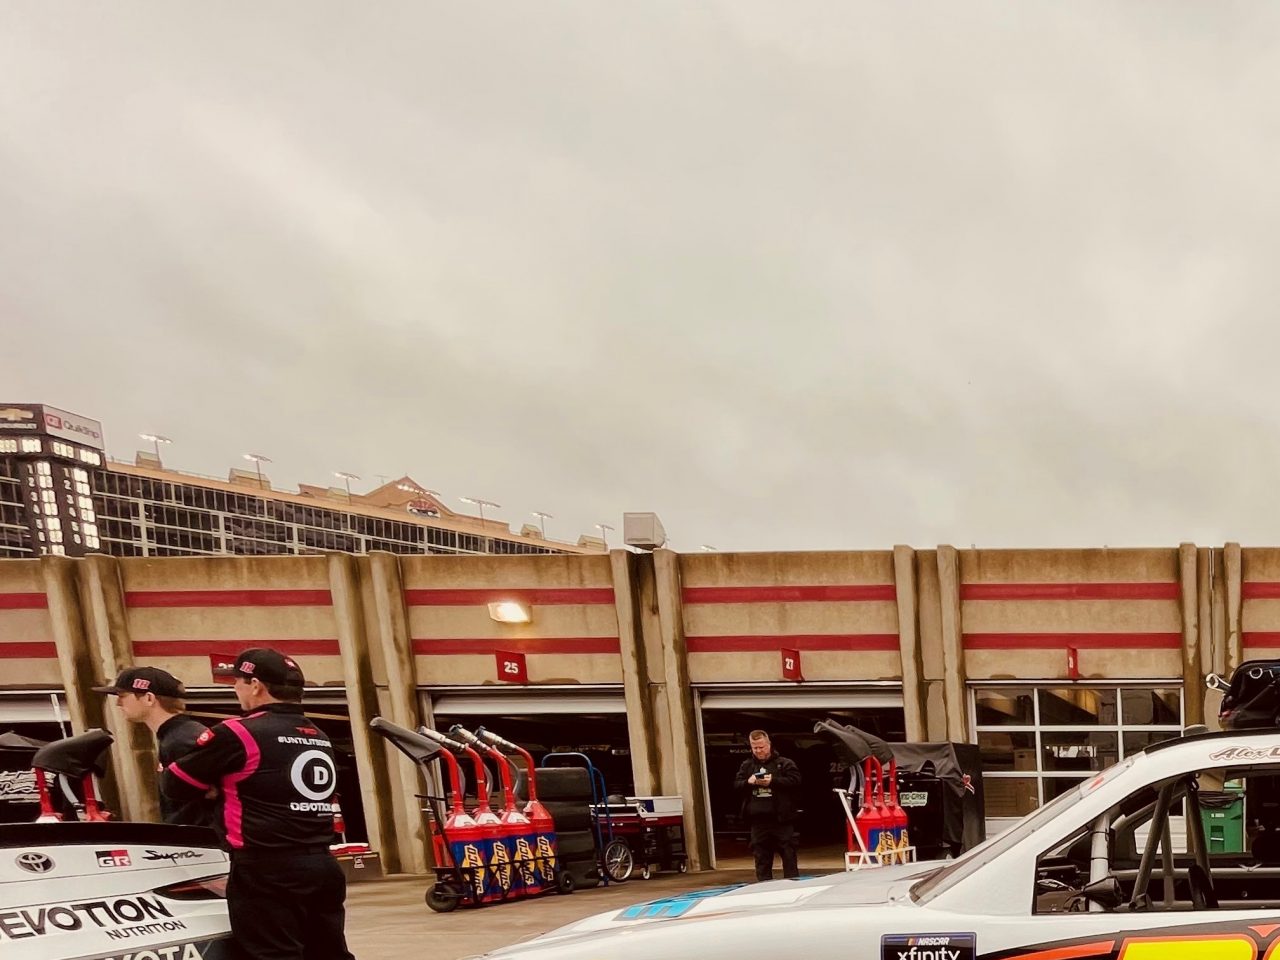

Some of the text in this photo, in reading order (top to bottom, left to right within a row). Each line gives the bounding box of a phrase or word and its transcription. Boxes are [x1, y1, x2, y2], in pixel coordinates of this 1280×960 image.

[504, 661, 519, 674] 25
[1210, 746, 1270, 761] Alex
[98, 856, 131, 867] GR
[142, 849, 203, 864] Supra
[105, 920, 188, 940] NUTRITION
[918, 937, 950, 946] NASCAR
